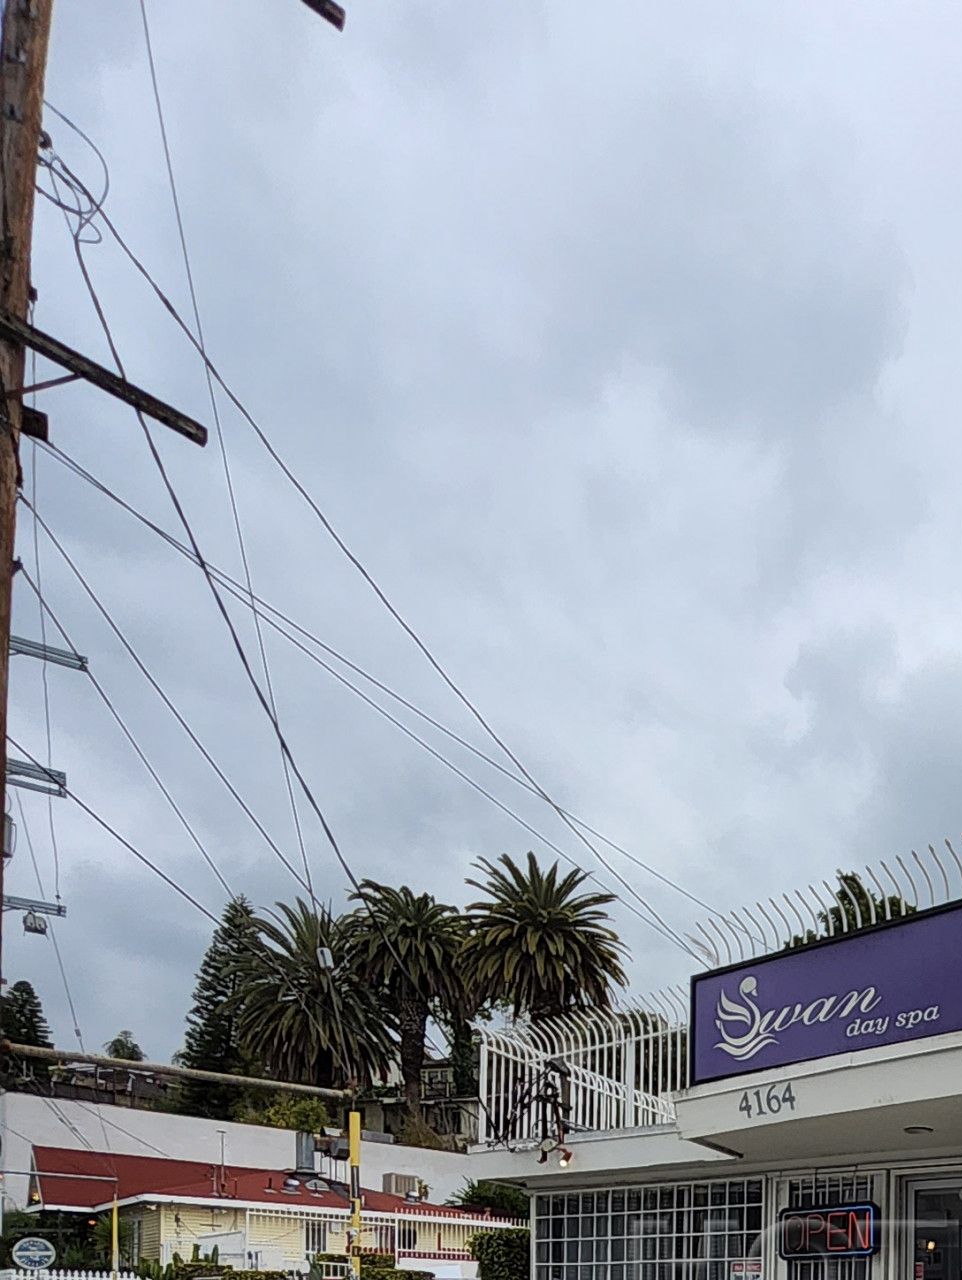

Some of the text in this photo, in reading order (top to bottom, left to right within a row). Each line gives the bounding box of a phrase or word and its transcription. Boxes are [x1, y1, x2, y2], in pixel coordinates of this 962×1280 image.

[715, 976, 881, 1056] Swan
[846, 1004, 940, 1038] day spa
[738, 1082, 796, 1118] 4164
[784, 1211, 870, 1251] OPEN
